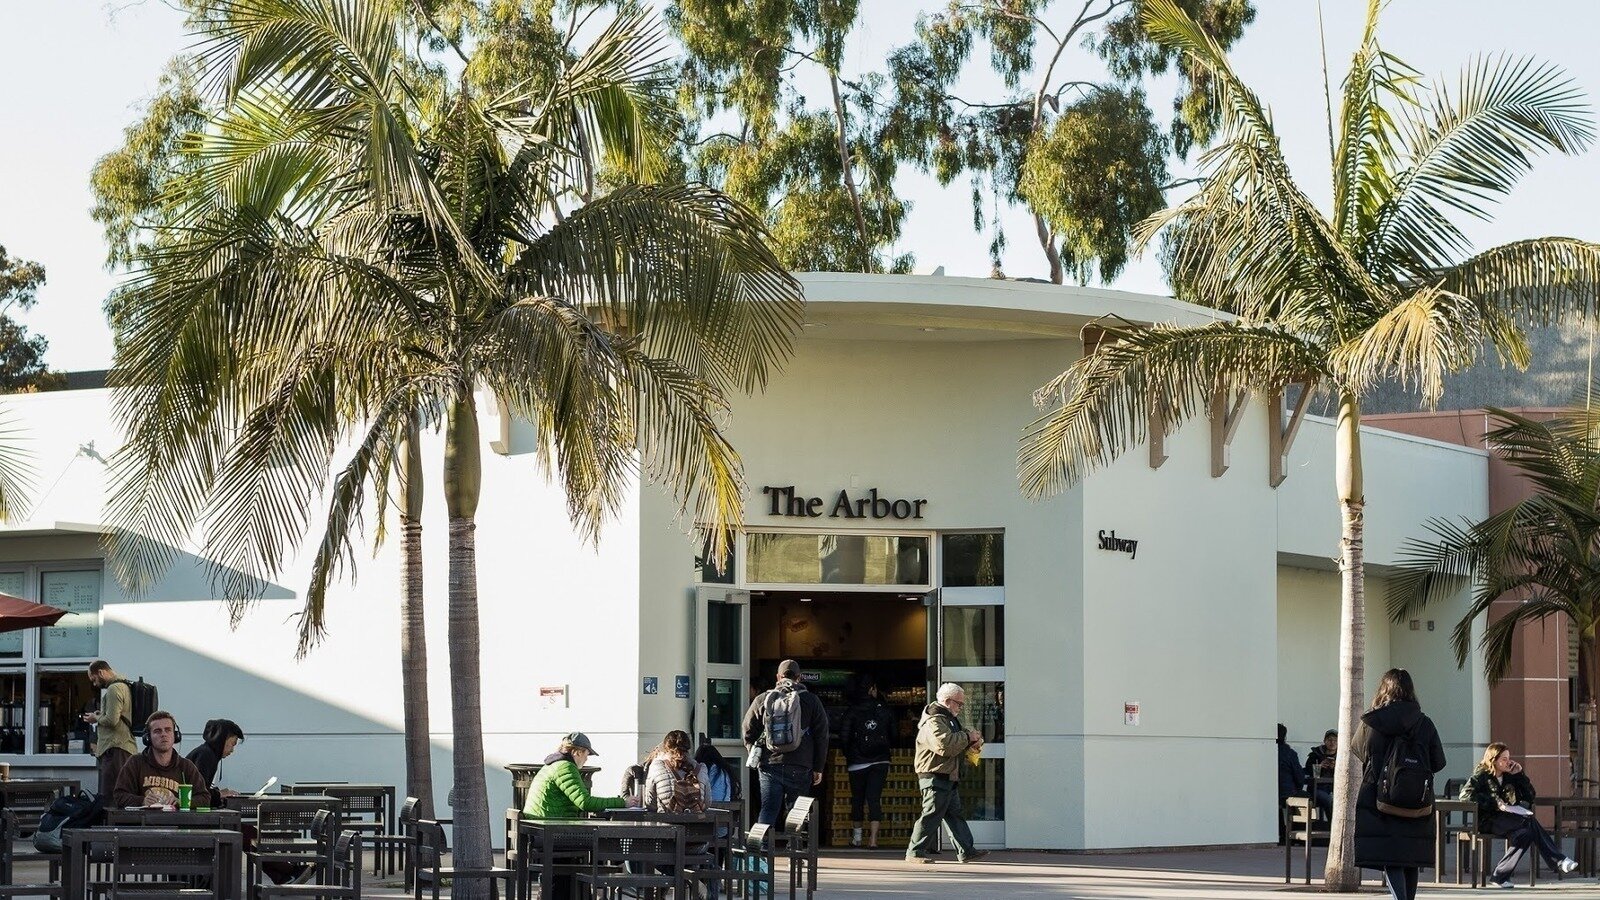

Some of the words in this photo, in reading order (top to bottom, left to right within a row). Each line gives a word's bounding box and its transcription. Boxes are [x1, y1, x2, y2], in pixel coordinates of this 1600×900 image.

[763, 485, 824, 518] The
[829, 487, 928, 519] Arbor
[1098, 529, 1138, 560] Subway
